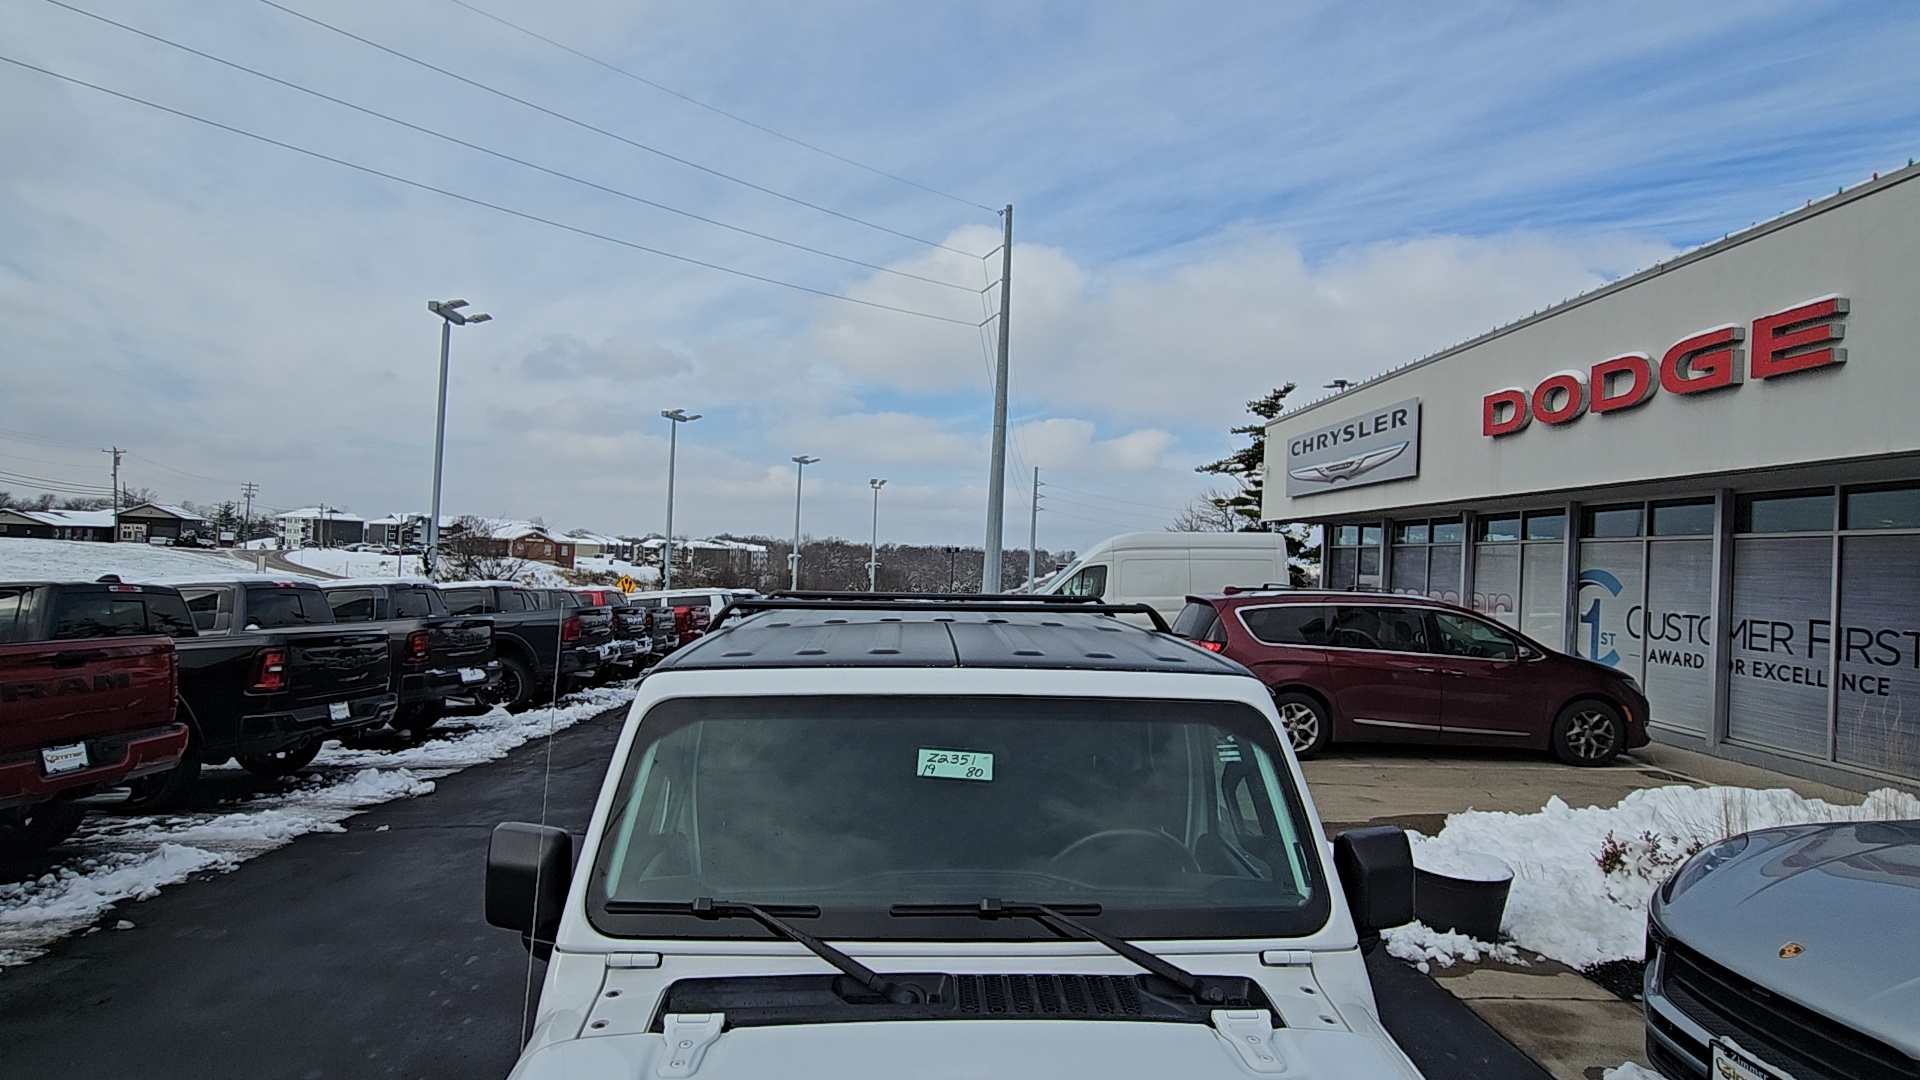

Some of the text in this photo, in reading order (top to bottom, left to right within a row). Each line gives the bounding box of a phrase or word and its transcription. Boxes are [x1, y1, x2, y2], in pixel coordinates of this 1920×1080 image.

[1483, 294, 1849, 437] DODGE
[1291, 408, 1408, 456] CHRYSLER
[2, 673, 131, 702] RAM
[1648, 649, 1704, 669] AWARD
[1752, 661, 1890, 697] EXCELLNCE
[965, 767, 984, 778] 80
